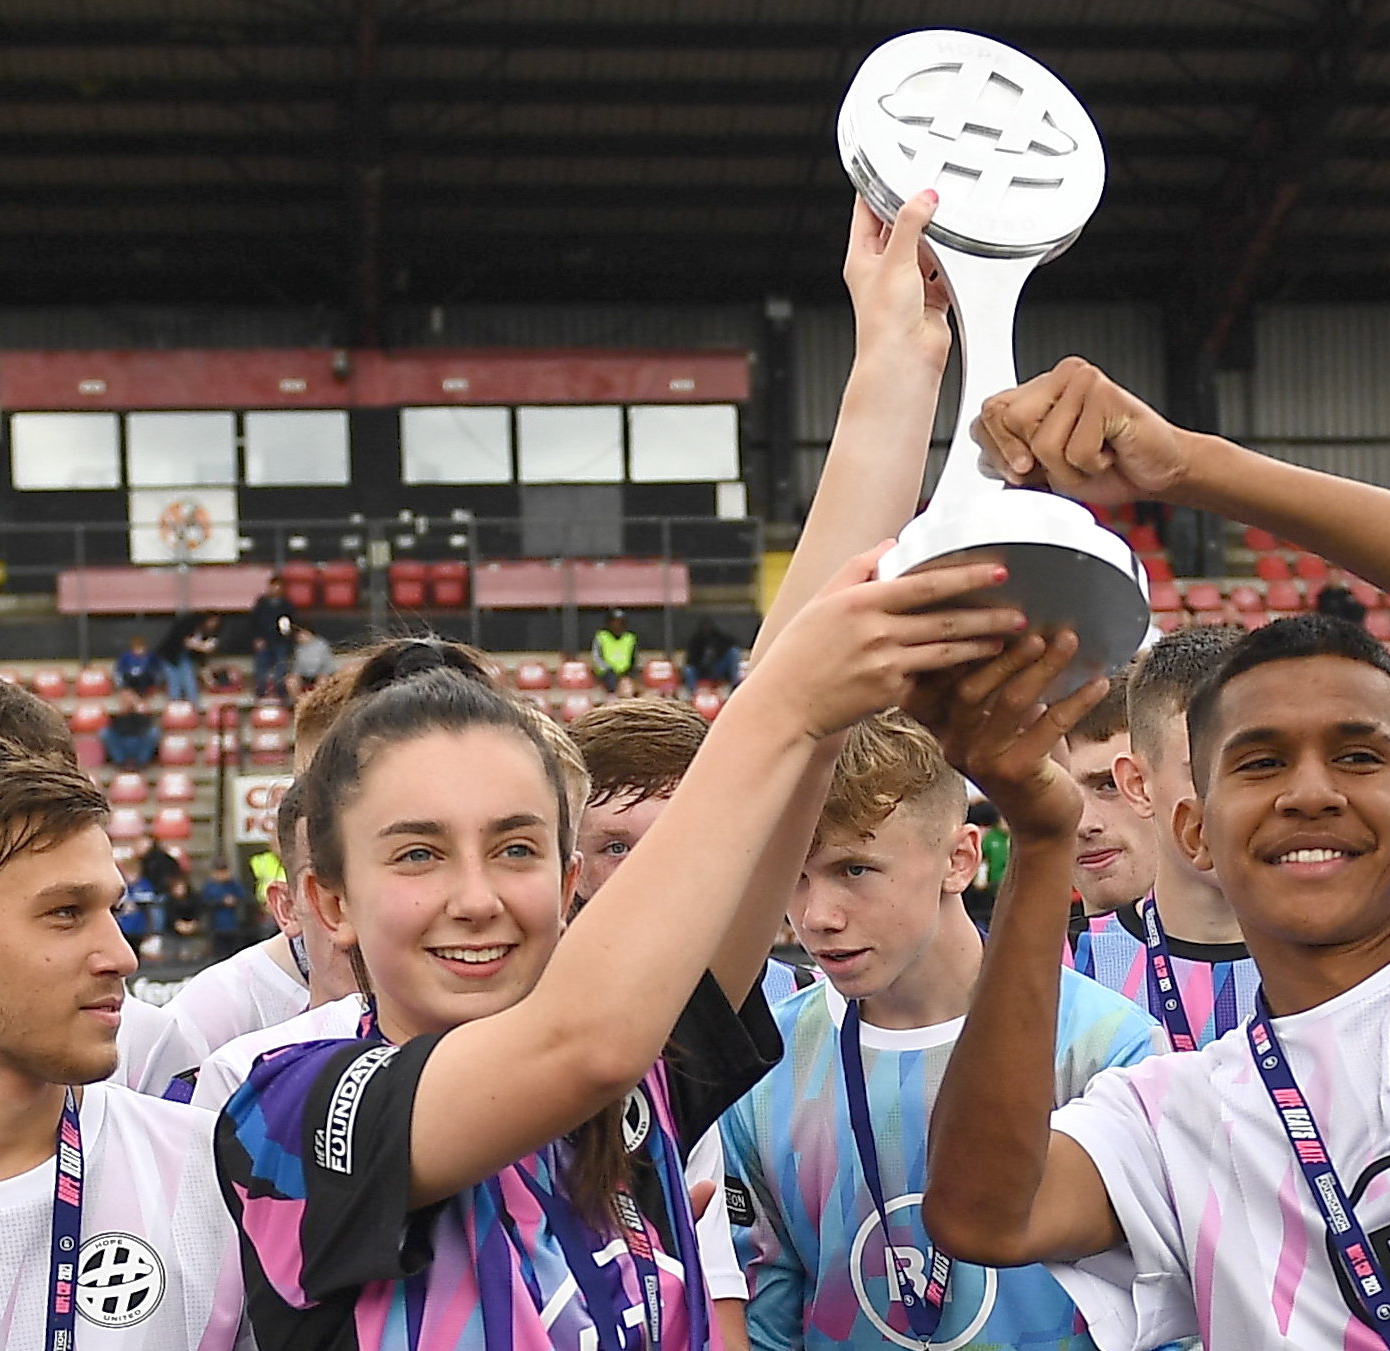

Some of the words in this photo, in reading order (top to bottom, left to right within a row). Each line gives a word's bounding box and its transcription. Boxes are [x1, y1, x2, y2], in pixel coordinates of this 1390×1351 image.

[331, 1046, 394, 1174] FOUNDATIO
[315, 1129, 327, 1168] UEFA
[625, 1121, 648, 1151] NITED
[95, 1238, 124, 1249] HOPE
[103, 1309, 142, 1322] UNITED
